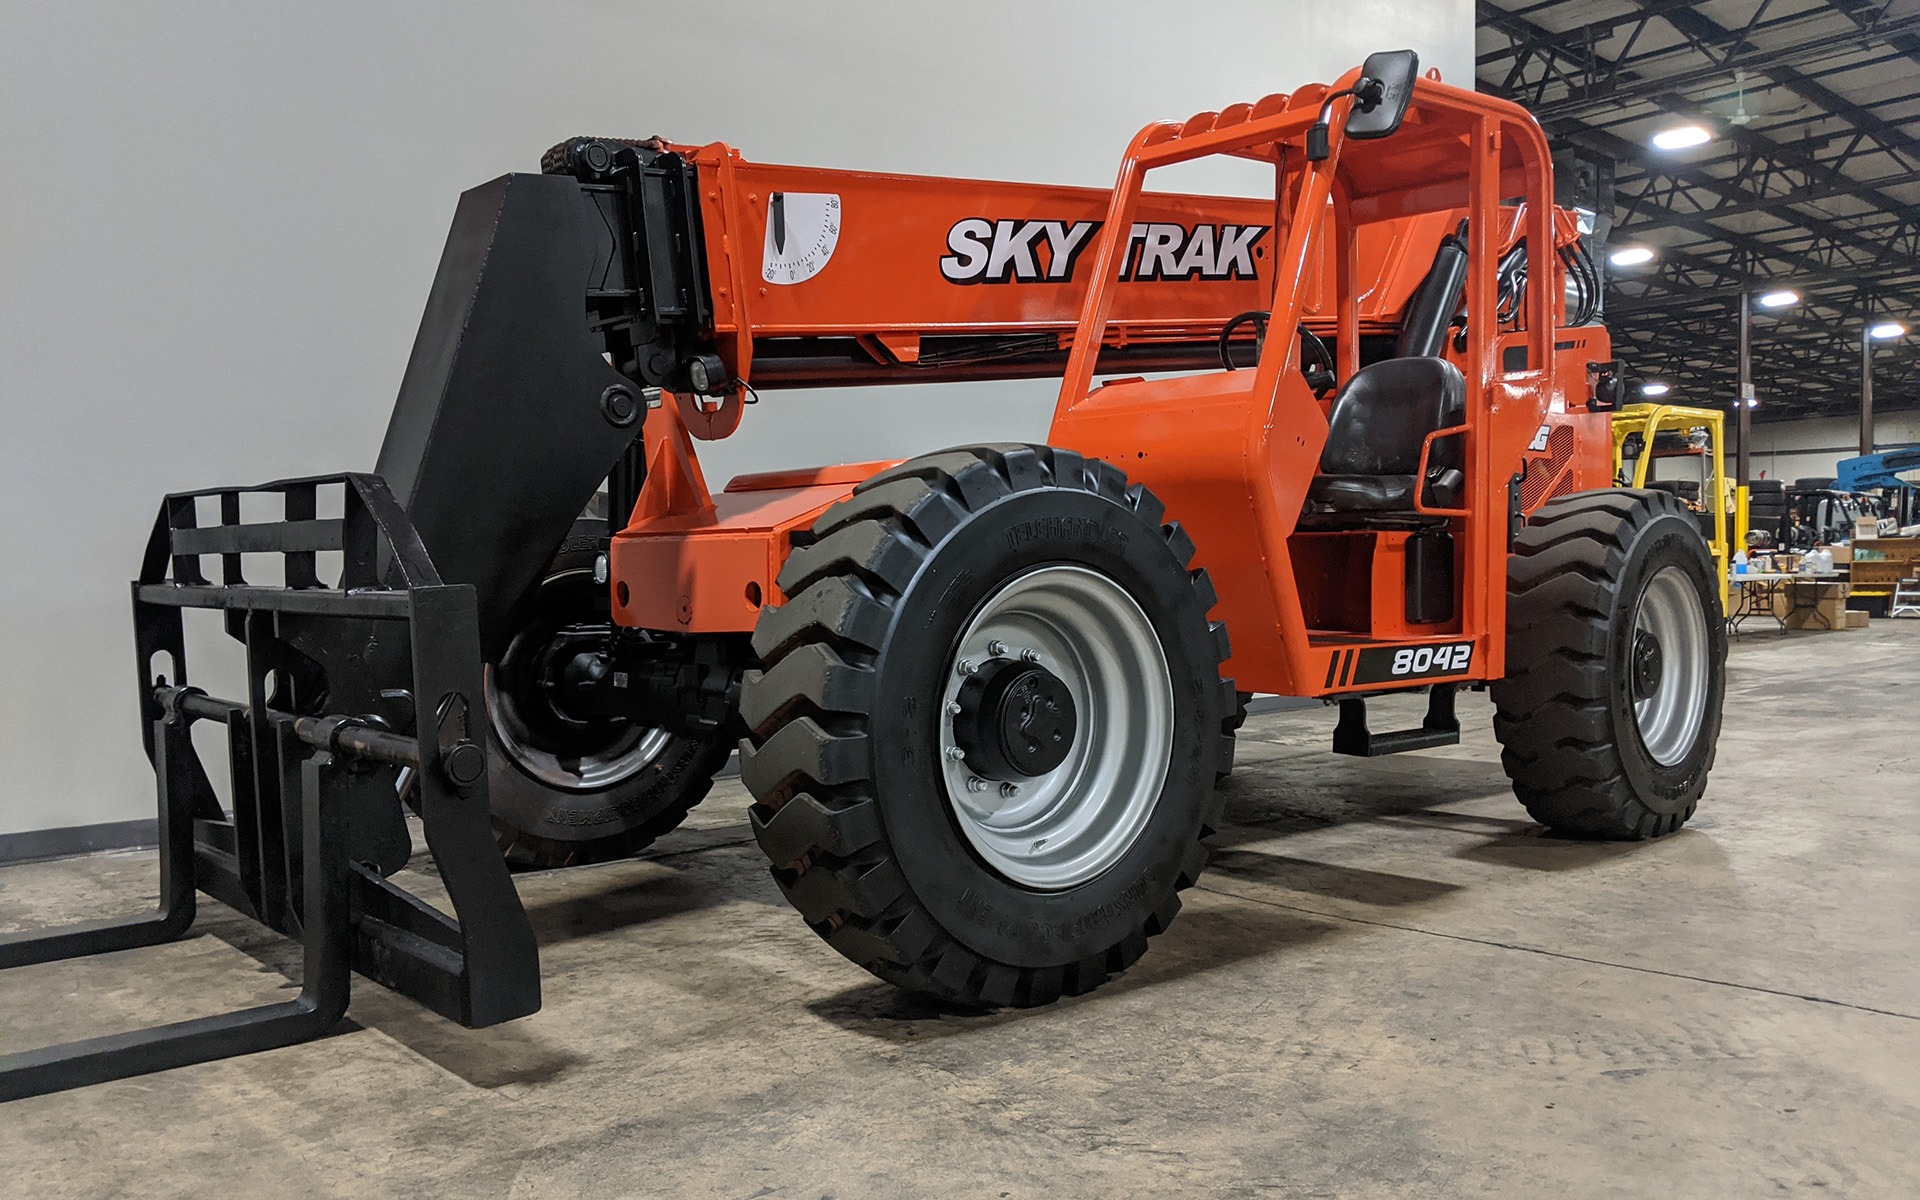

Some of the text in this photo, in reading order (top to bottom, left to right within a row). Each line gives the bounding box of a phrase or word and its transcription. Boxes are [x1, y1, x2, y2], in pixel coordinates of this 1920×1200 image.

[940, 217, 1269, 282] SKY TRAK
[1528, 425, 1550, 450] G
[1391, 645, 1471, 675] 8042
